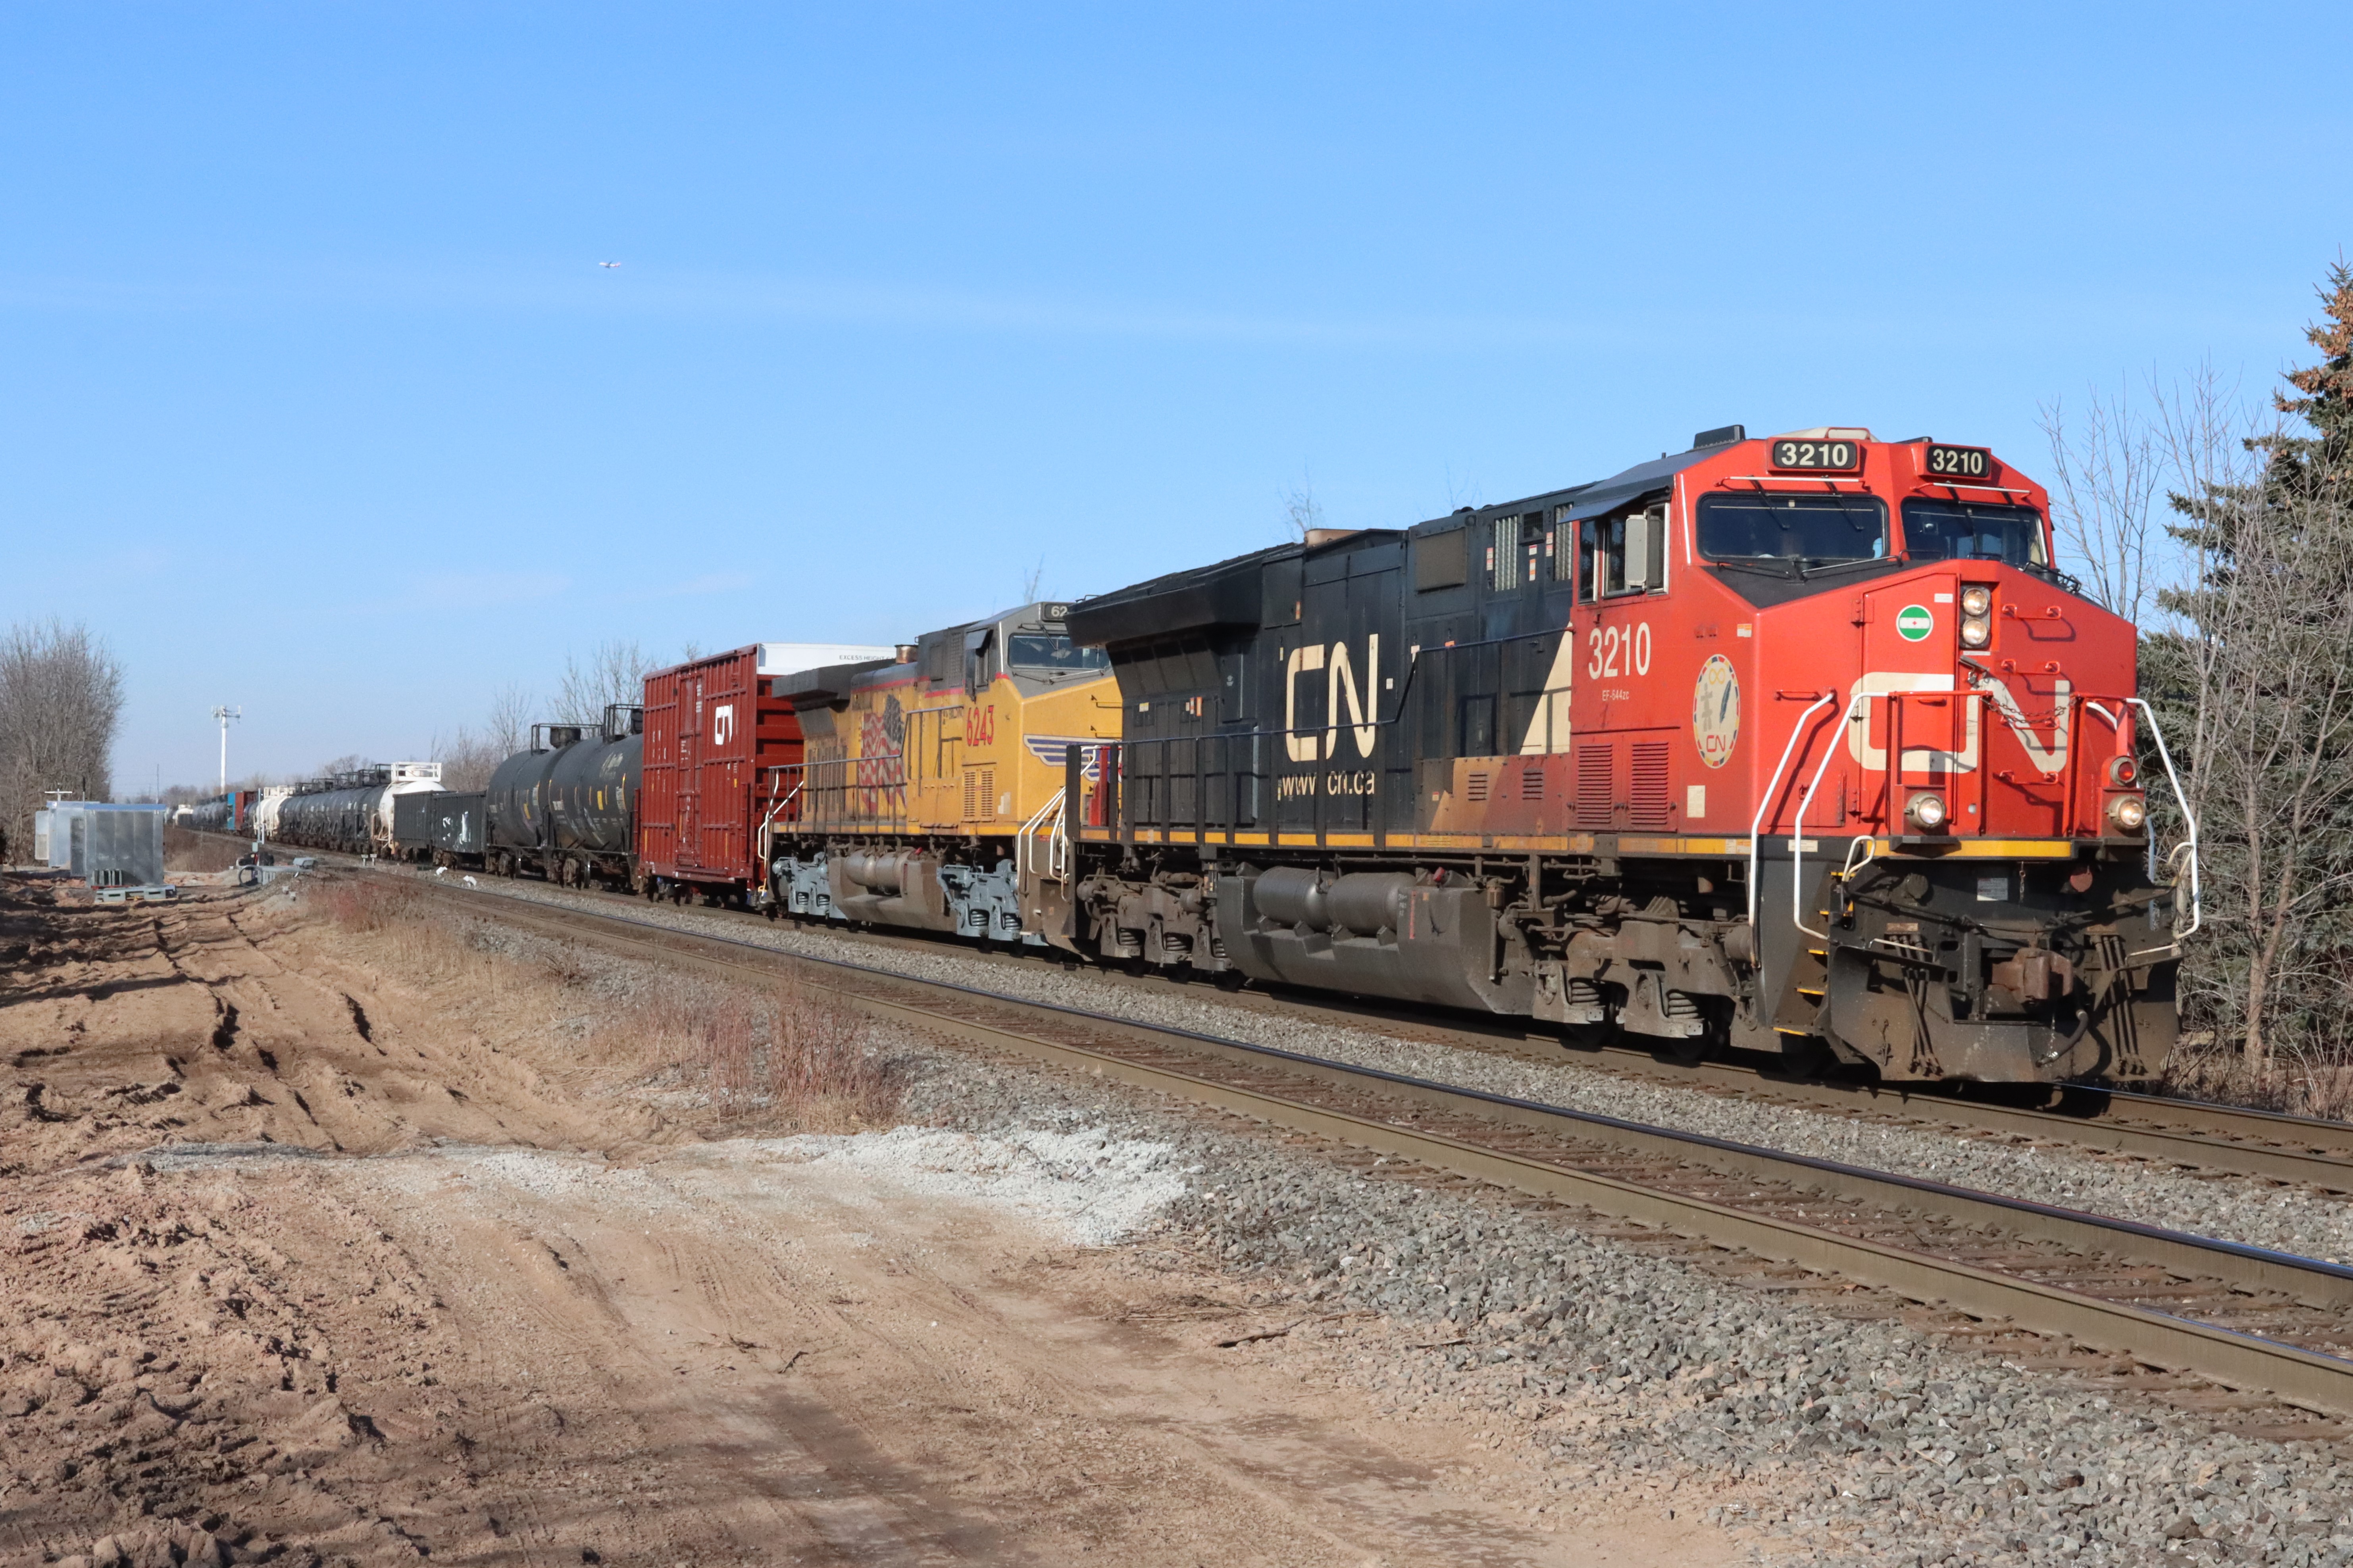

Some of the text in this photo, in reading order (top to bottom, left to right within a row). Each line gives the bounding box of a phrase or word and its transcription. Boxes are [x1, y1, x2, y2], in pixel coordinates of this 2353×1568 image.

[1781, 443, 1848, 466] 3210
[1932, 449, 1982, 474] 3210
[1051, 605, 1068, 617] 62
[1588, 622, 1651, 680] 3210
[1285, 633, 1379, 762] CN
[966, 705, 994, 746] 6243
[1847, 671, 2071, 774] CN
[1706, 735, 1726, 753] CN
[1282, 770, 1375, 796] wwwcn.ca
